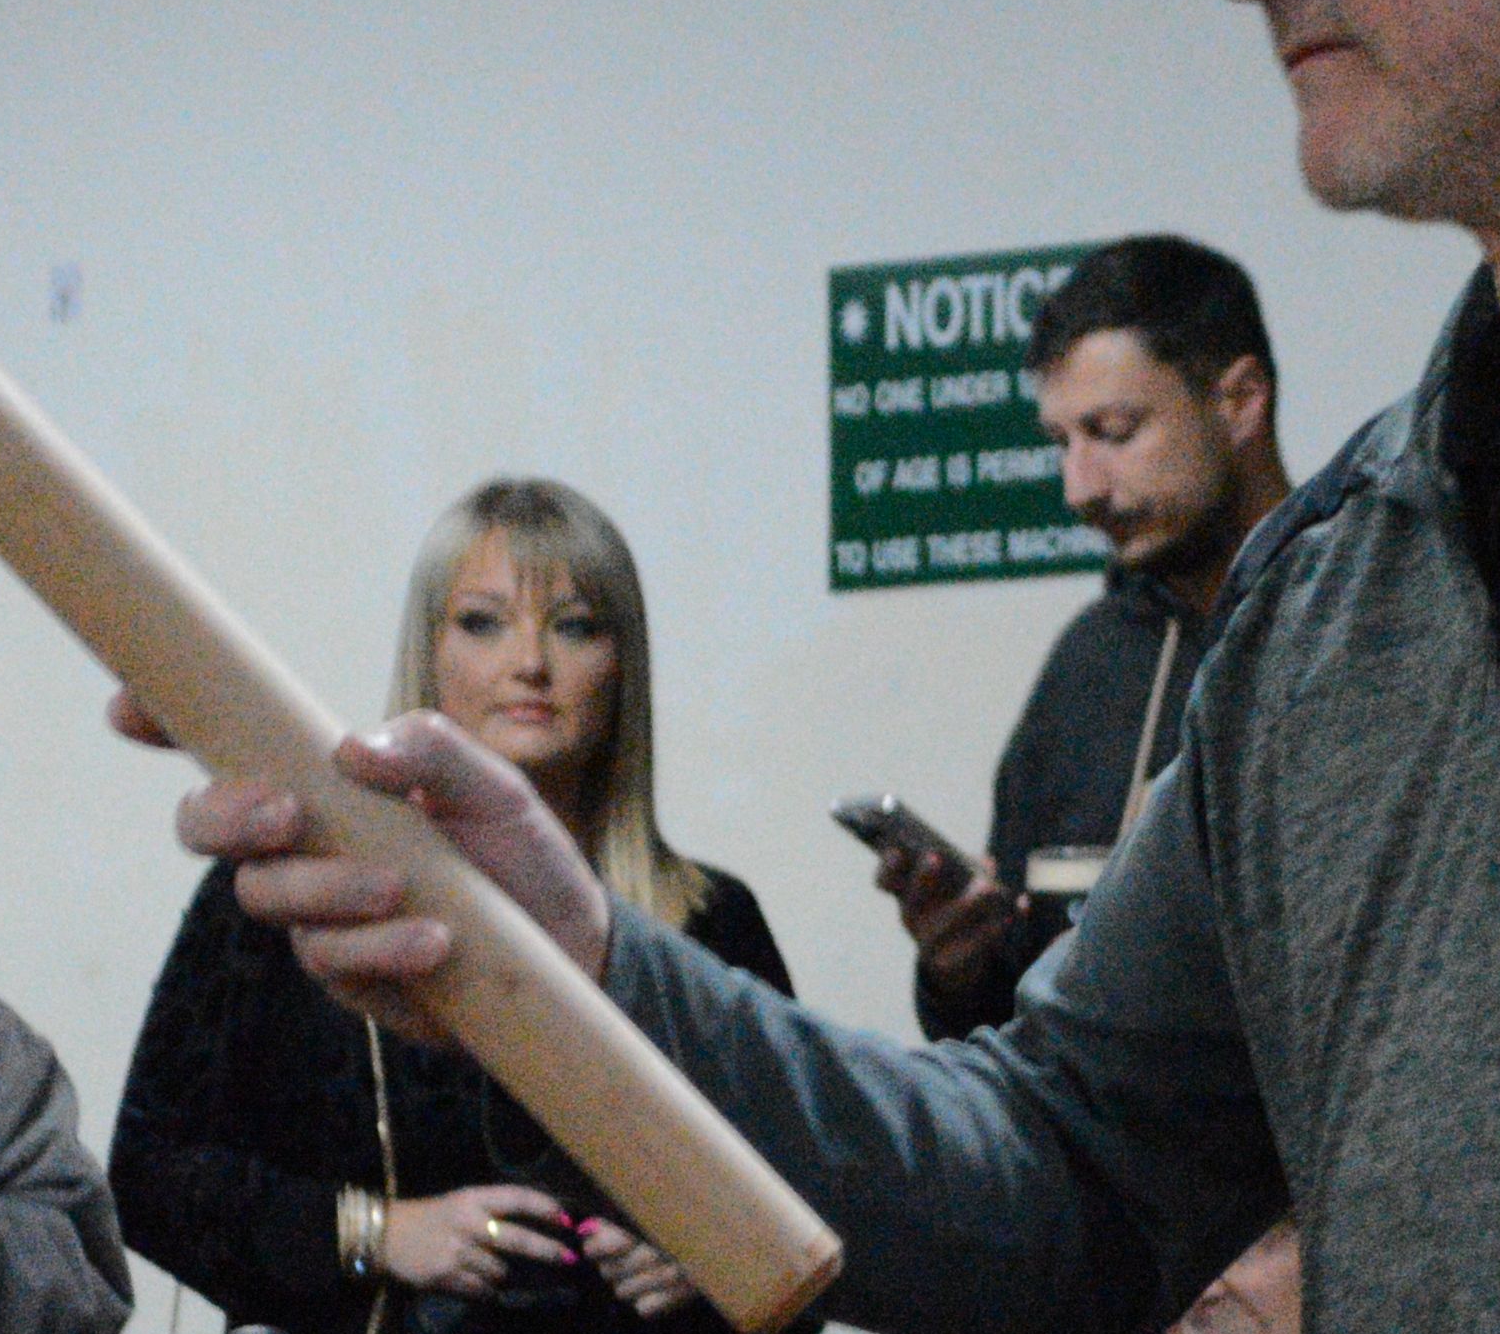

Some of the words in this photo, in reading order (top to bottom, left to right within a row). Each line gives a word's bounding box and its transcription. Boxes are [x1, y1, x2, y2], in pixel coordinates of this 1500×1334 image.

[884, 266, 1076, 351] NOTIC
[833, 381, 870, 415] NO
[929, 369, 1011, 409] UNDER
[892, 455, 940, 491] AGE
[835, 539, 868, 574] TO
[926, 529, 1002, 567] THESE
